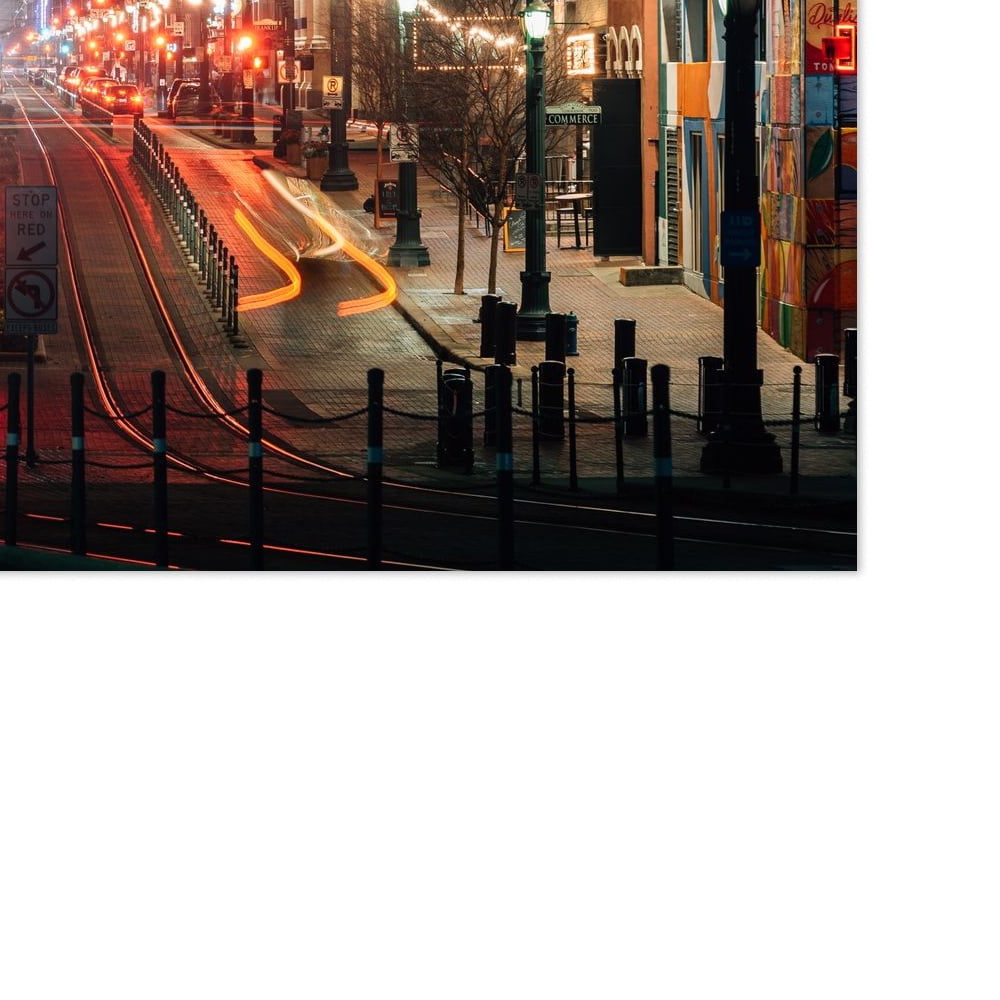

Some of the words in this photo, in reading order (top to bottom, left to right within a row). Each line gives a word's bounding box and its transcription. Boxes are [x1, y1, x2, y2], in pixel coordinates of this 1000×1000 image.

[548, 114, 598, 124] COMMERCE
[12, 193, 50, 207] STOP
[10, 210, 34, 219] HERE
[40, 210, 53, 219] ON
[17, 223, 46, 236] RED
